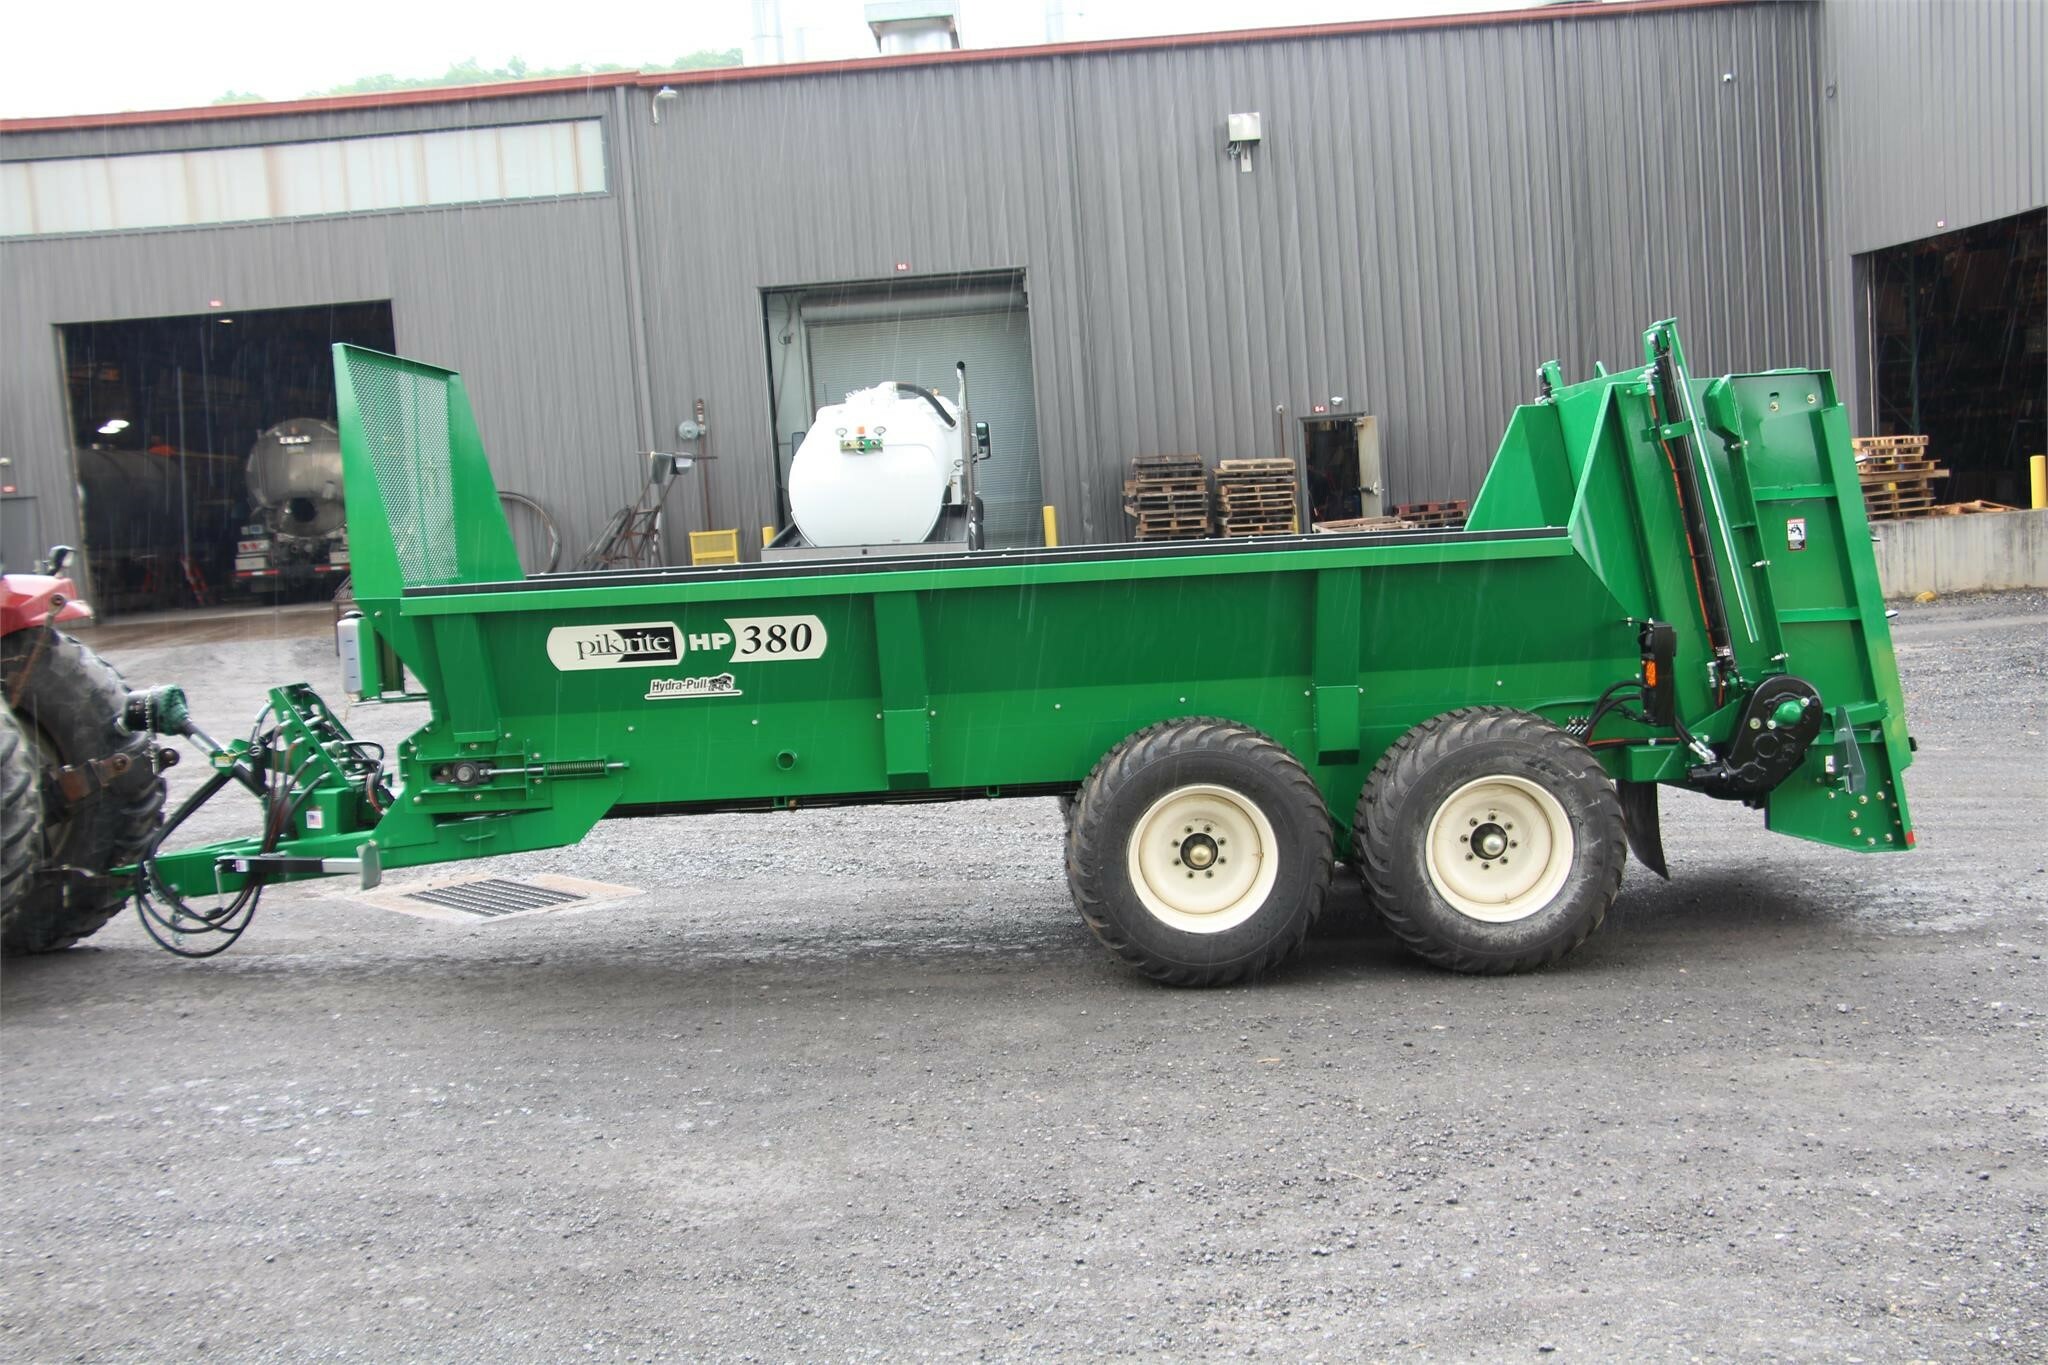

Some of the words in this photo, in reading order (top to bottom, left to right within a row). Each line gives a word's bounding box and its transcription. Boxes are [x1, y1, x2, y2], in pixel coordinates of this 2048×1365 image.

[576, 631, 670, 660] pikrite
[688, 632, 731, 651] HP
[741, 623, 812, 654] 380
[652, 678, 707, 692] Hydra-Pull
